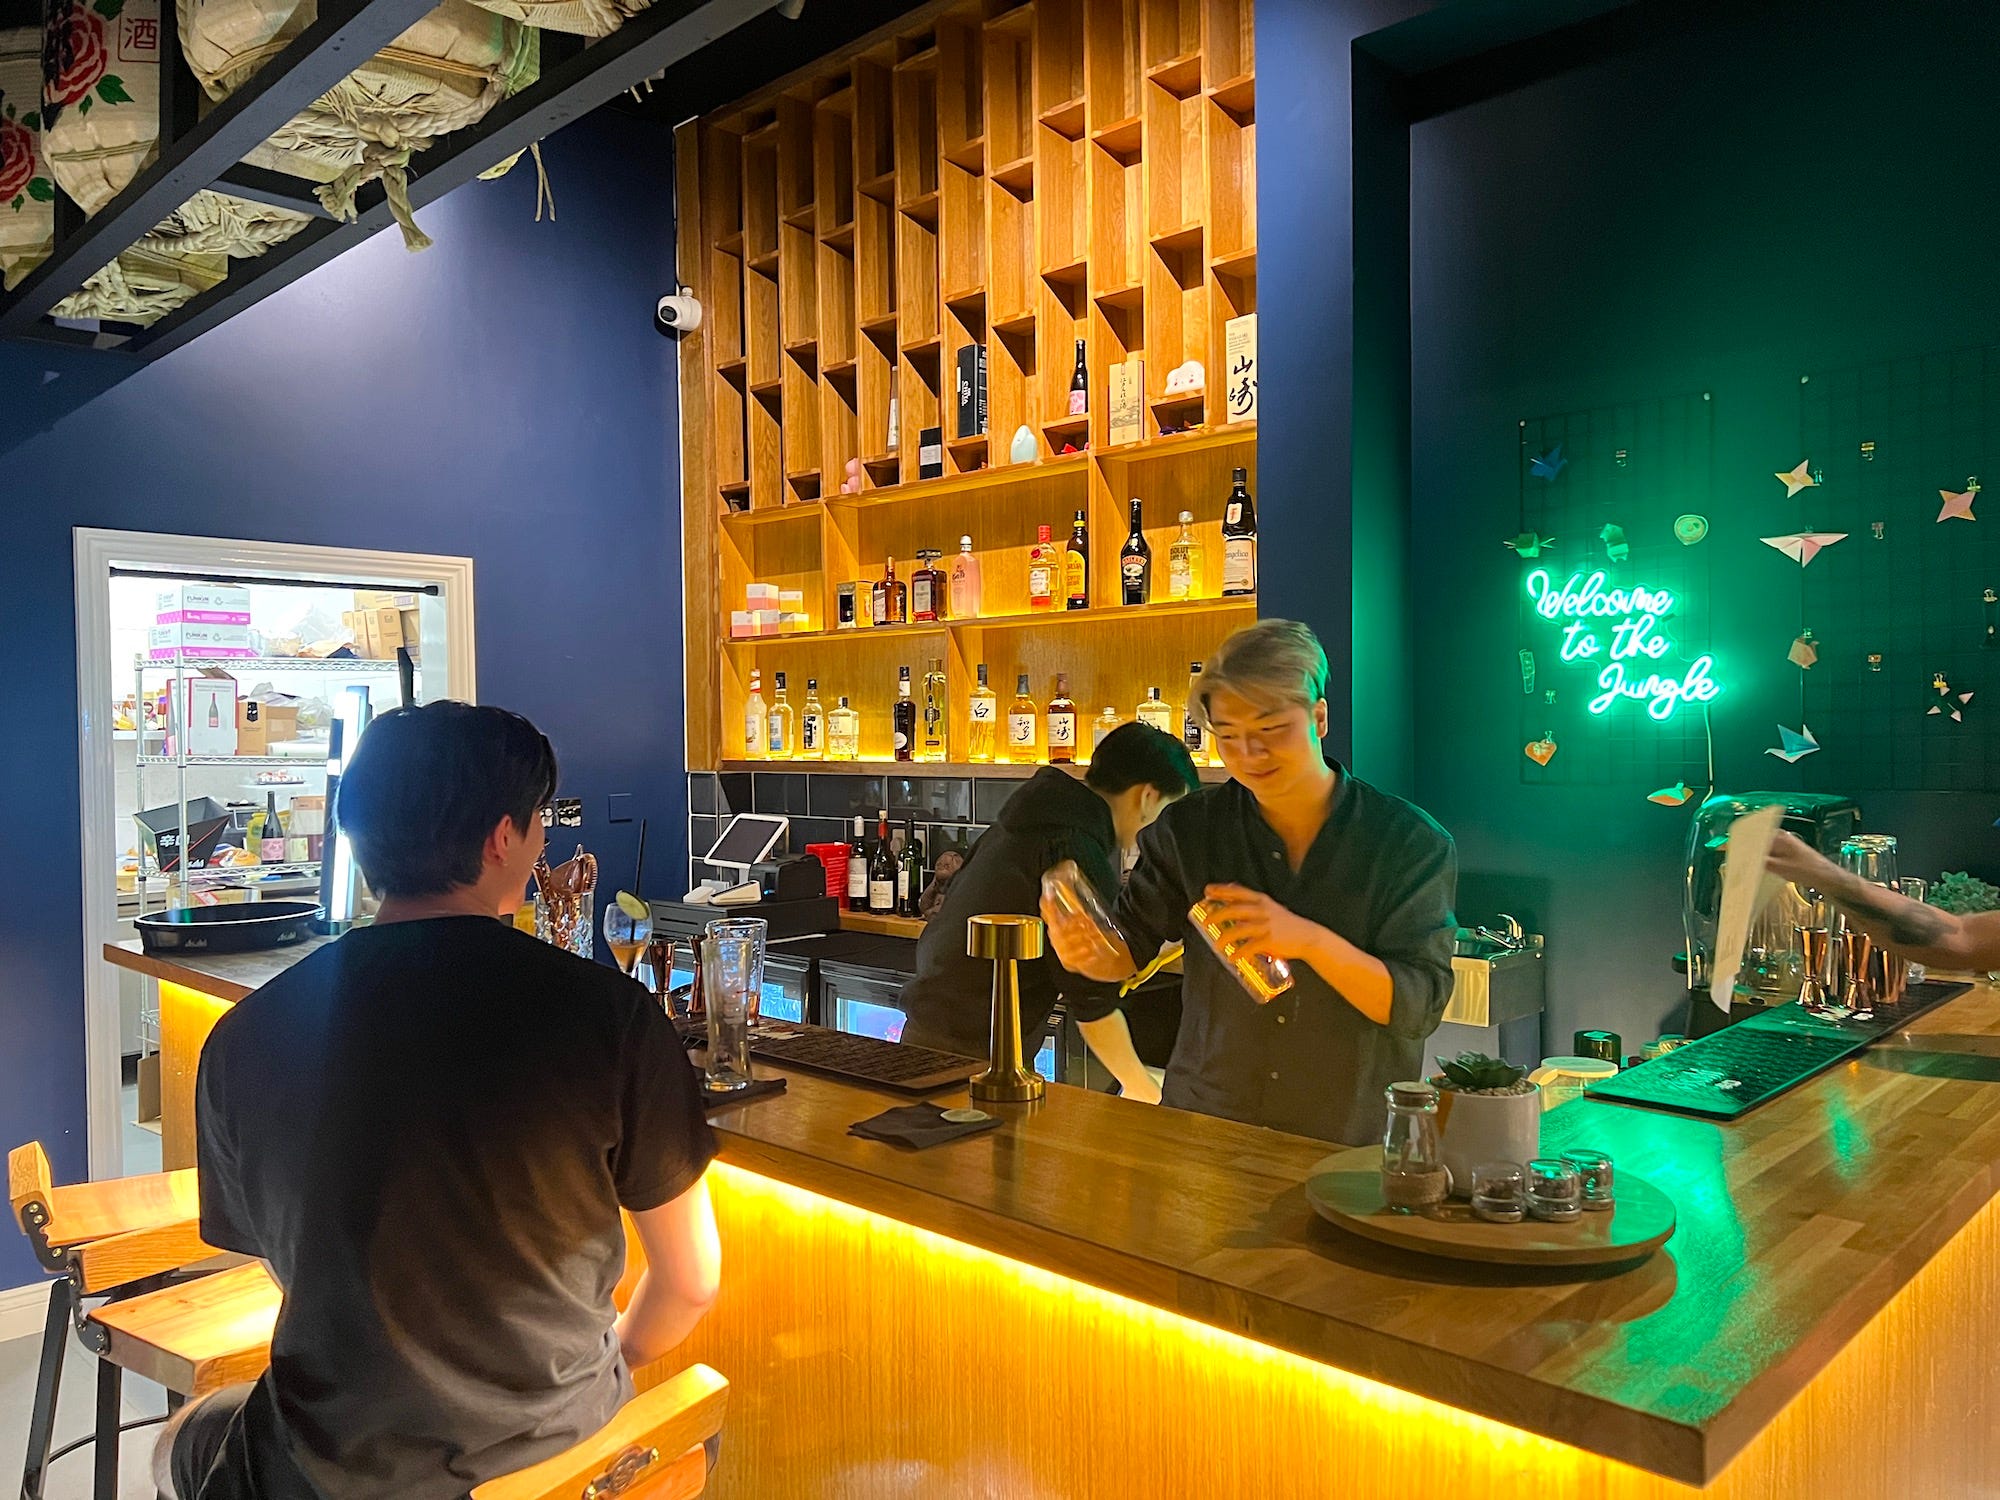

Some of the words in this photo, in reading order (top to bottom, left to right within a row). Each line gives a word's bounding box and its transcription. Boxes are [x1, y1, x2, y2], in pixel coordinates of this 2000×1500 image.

[124, 18, 158, 50] 酒
[1525, 569, 1675, 619] Welcome
[1559, 618, 1602, 661] to
[1609, 613, 1671, 661] the
[1587, 655, 1721, 720] Jungle
